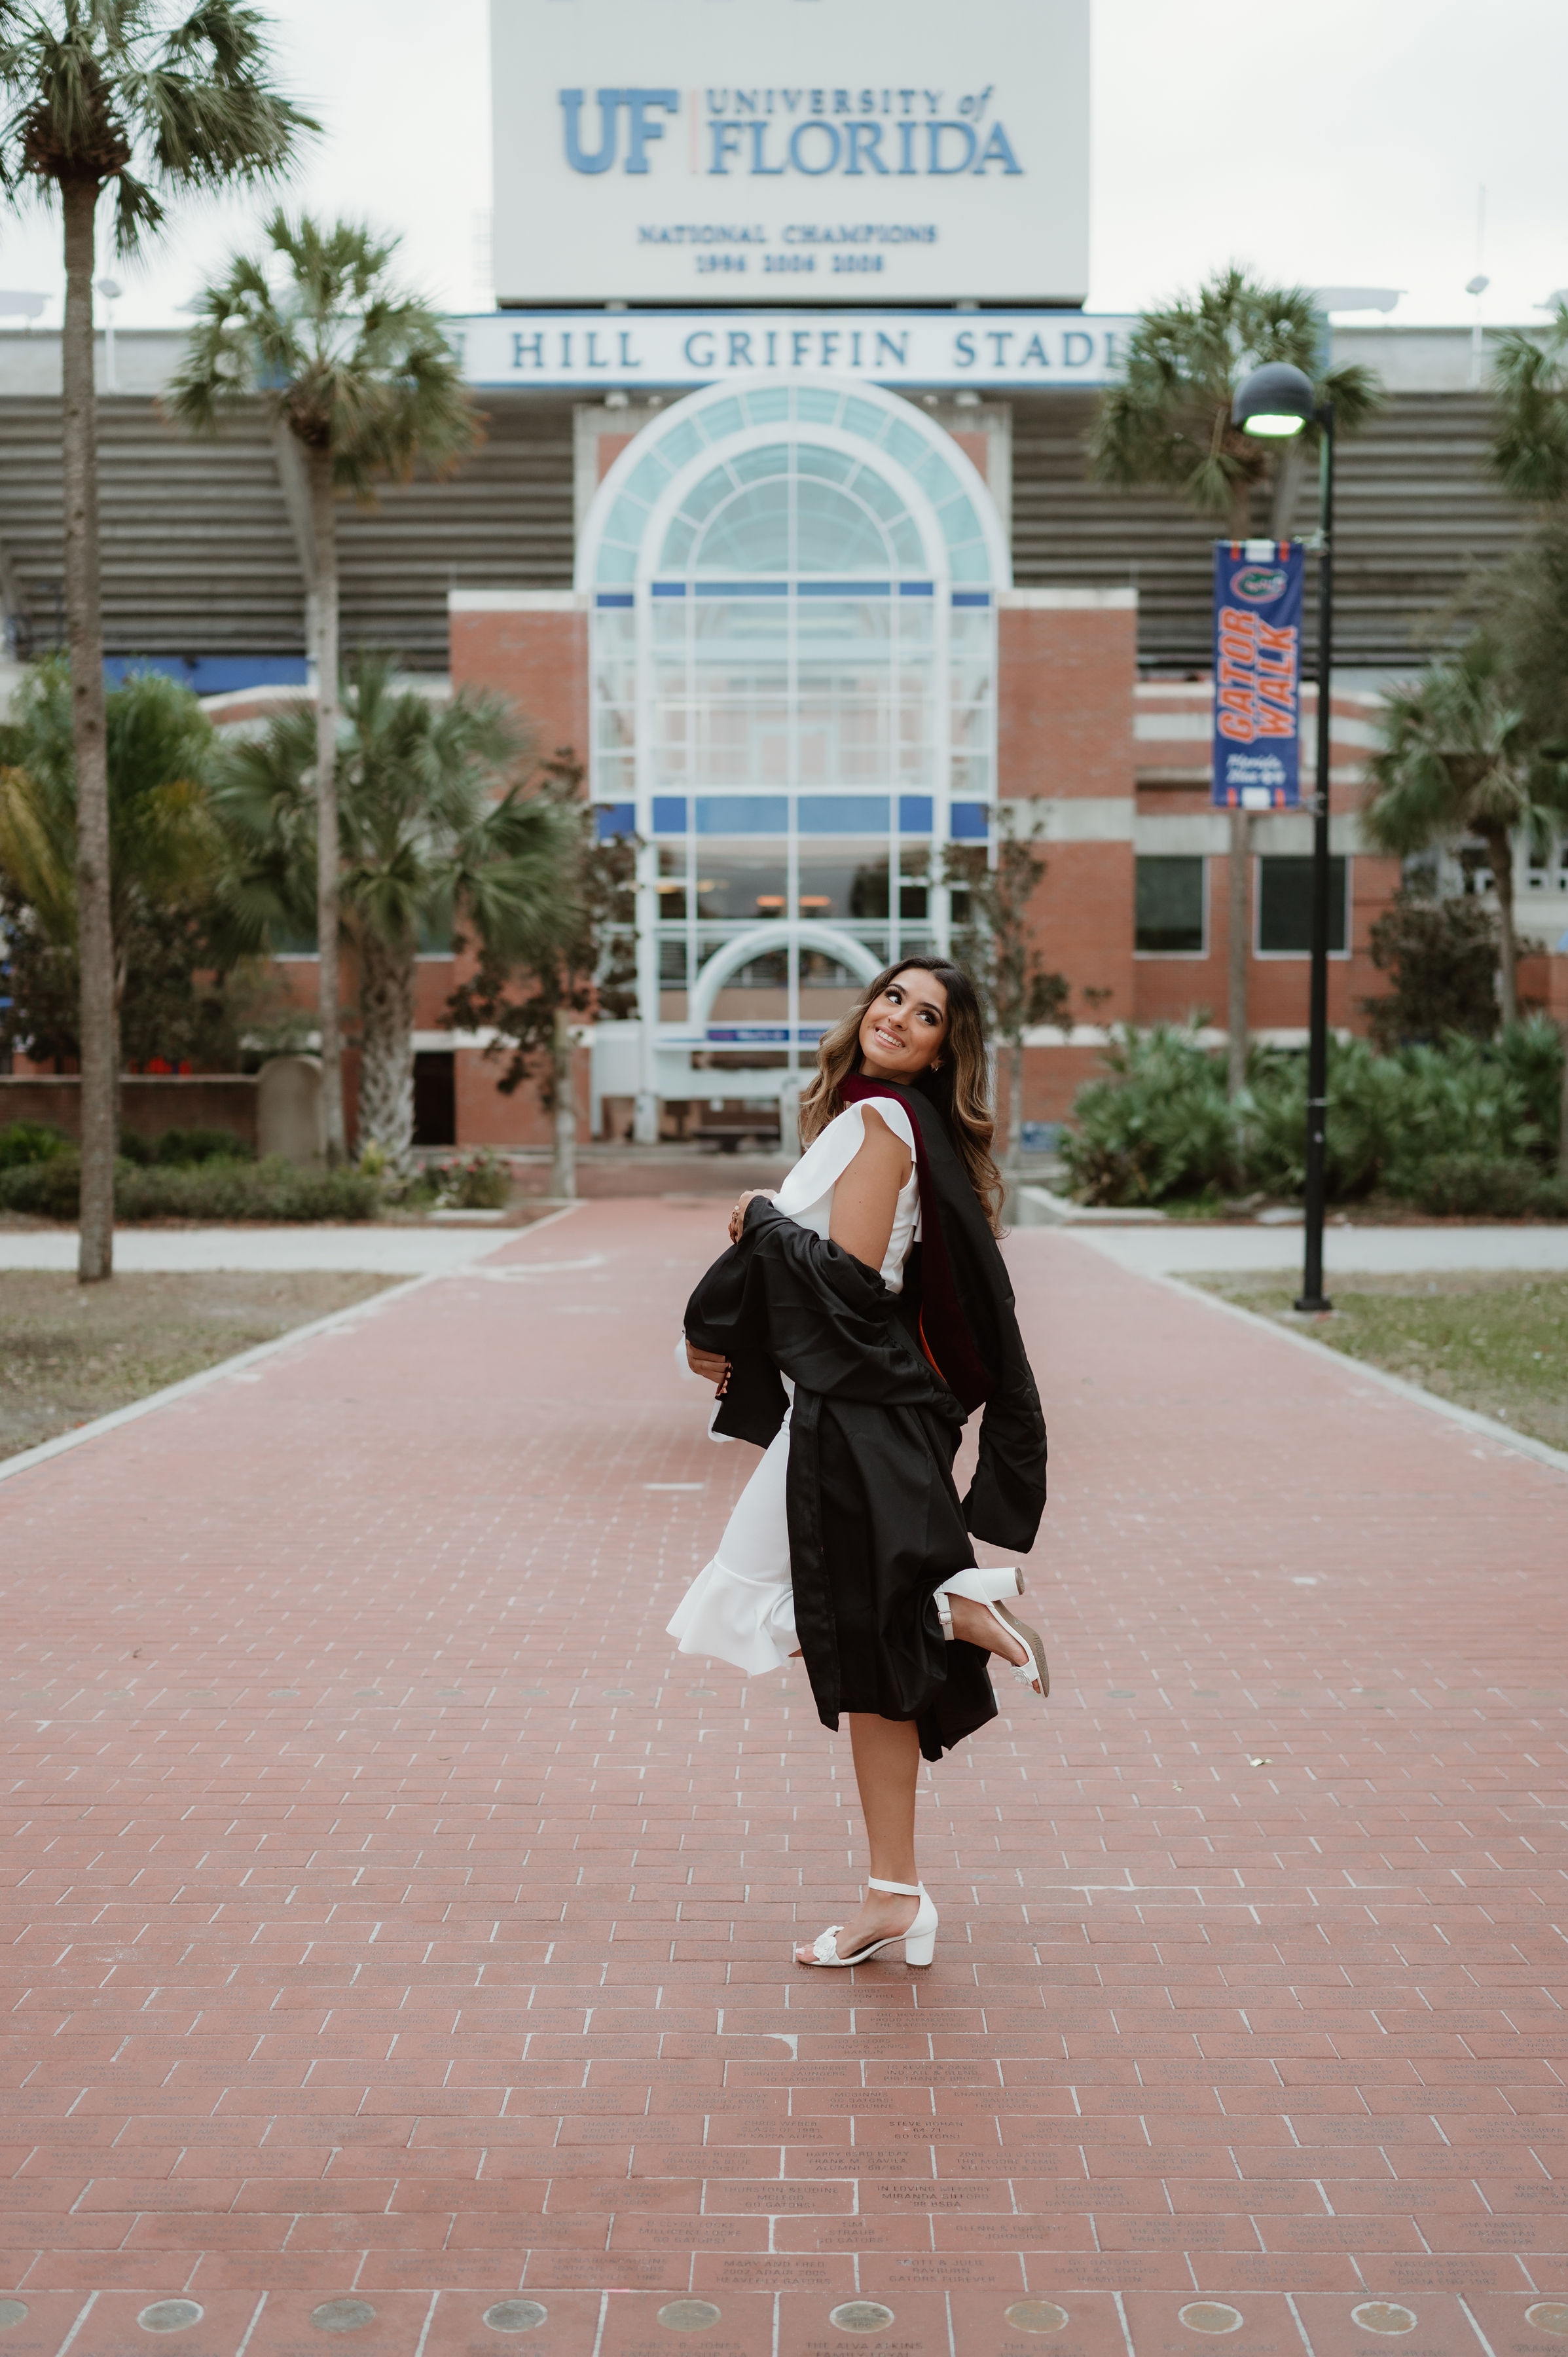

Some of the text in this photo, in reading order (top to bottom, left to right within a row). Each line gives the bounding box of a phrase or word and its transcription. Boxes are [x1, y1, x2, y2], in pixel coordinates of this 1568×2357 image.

[706, 85, 994, 115] UNIVERSITY of
[556, 88, 680, 175] UF
[707, 120, 1025, 175] FLORIDA
[637, 225, 938, 244] NATIONAL CHAMPIONS
[511, 331, 1118, 369] HILL GRIFFIN STADI
[1218, 605, 1299, 744] GATOR WALK
